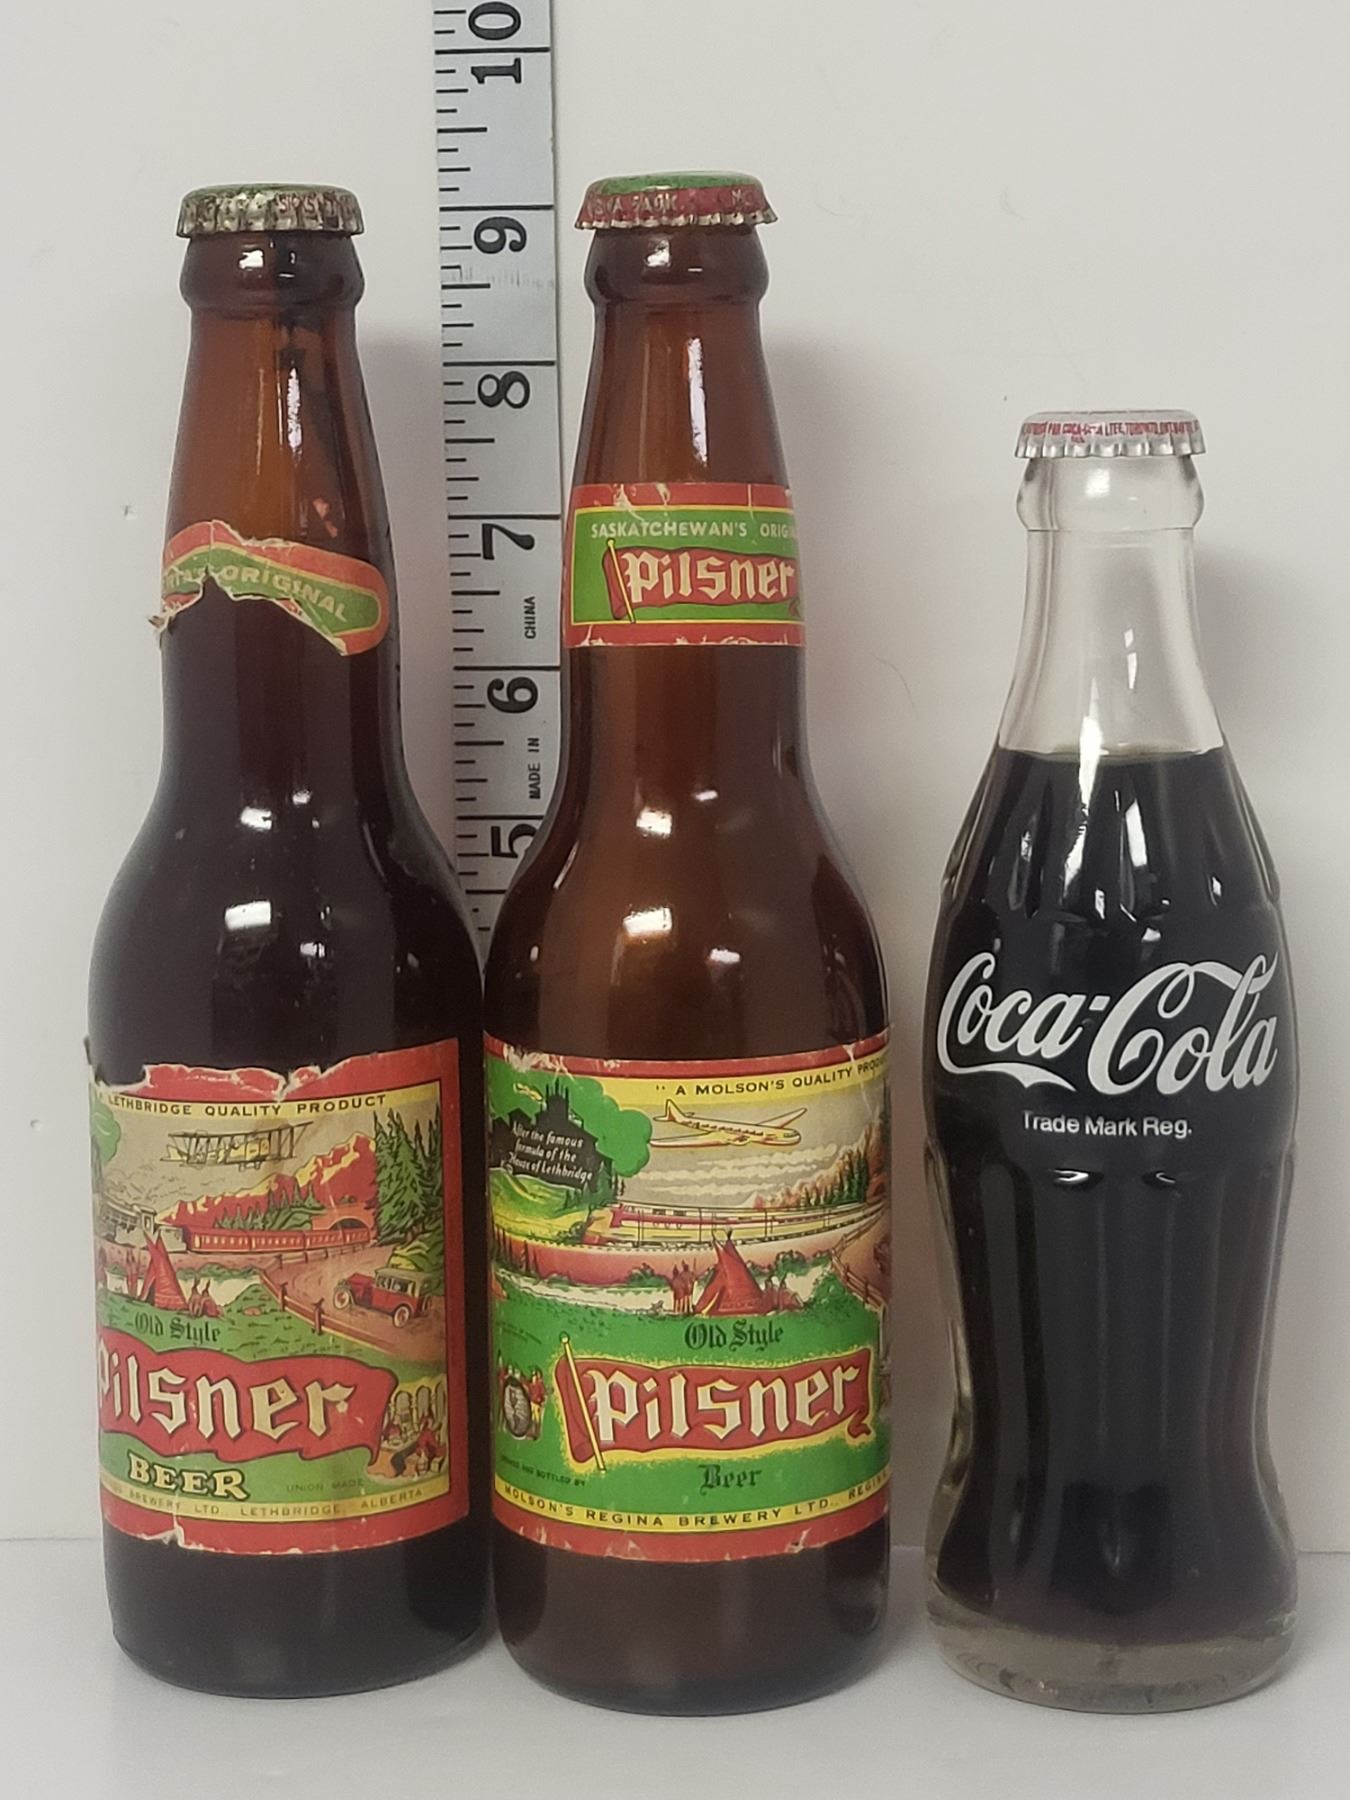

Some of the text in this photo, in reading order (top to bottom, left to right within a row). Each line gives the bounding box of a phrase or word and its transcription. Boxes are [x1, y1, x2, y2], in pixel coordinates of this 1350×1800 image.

[474, 216, 527, 254] 9
[478, 371, 530, 409] 8
[482, 523, 535, 560] 7
[591, 520, 795, 539] SASKATCHEWAN'S ORIG
[222, 564, 348, 623] ORIGINAL
[620, 551, 795, 603] Pilsner
[487, 677, 539, 714] 6
[523, 596, 541, 800] MADE IN CHINA
[490, 823, 538, 858] 5
[938, 951, 1278, 1095] Coca-Cola
[694, 1078, 786, 1096] MOLSON'S
[791, 1065, 854, 1089] QUALITY
[204, 1105, 282, 1117] QUALITY
[296, 1094, 387, 1114] PRODUCT
[530, 1130, 545, 1142] the
[545, 1129, 585, 1149] famous
[1023, 1110, 1193, 1140] Trade Mark Reg.
[514, 1137, 577, 1163] formula of the
[530, 1159, 542, 1174] of
[541, 1160, 593, 1185] Lethbridge
[135, 1311, 221, 1344] Old Style
[684, 1318, 784, 1352] Old Style
[586, 1362, 862, 1442] Pilsner
[126, 1449, 250, 1502] BEER
[699, 1463, 763, 1498] Beer
[360, 1489, 423, 1509] ALBERTA
[504, 1483, 574, 1517] MOLSON'S
[586, 1508, 664, 1527] REGINA
[679, 1508, 782, 1528] BREWERY
